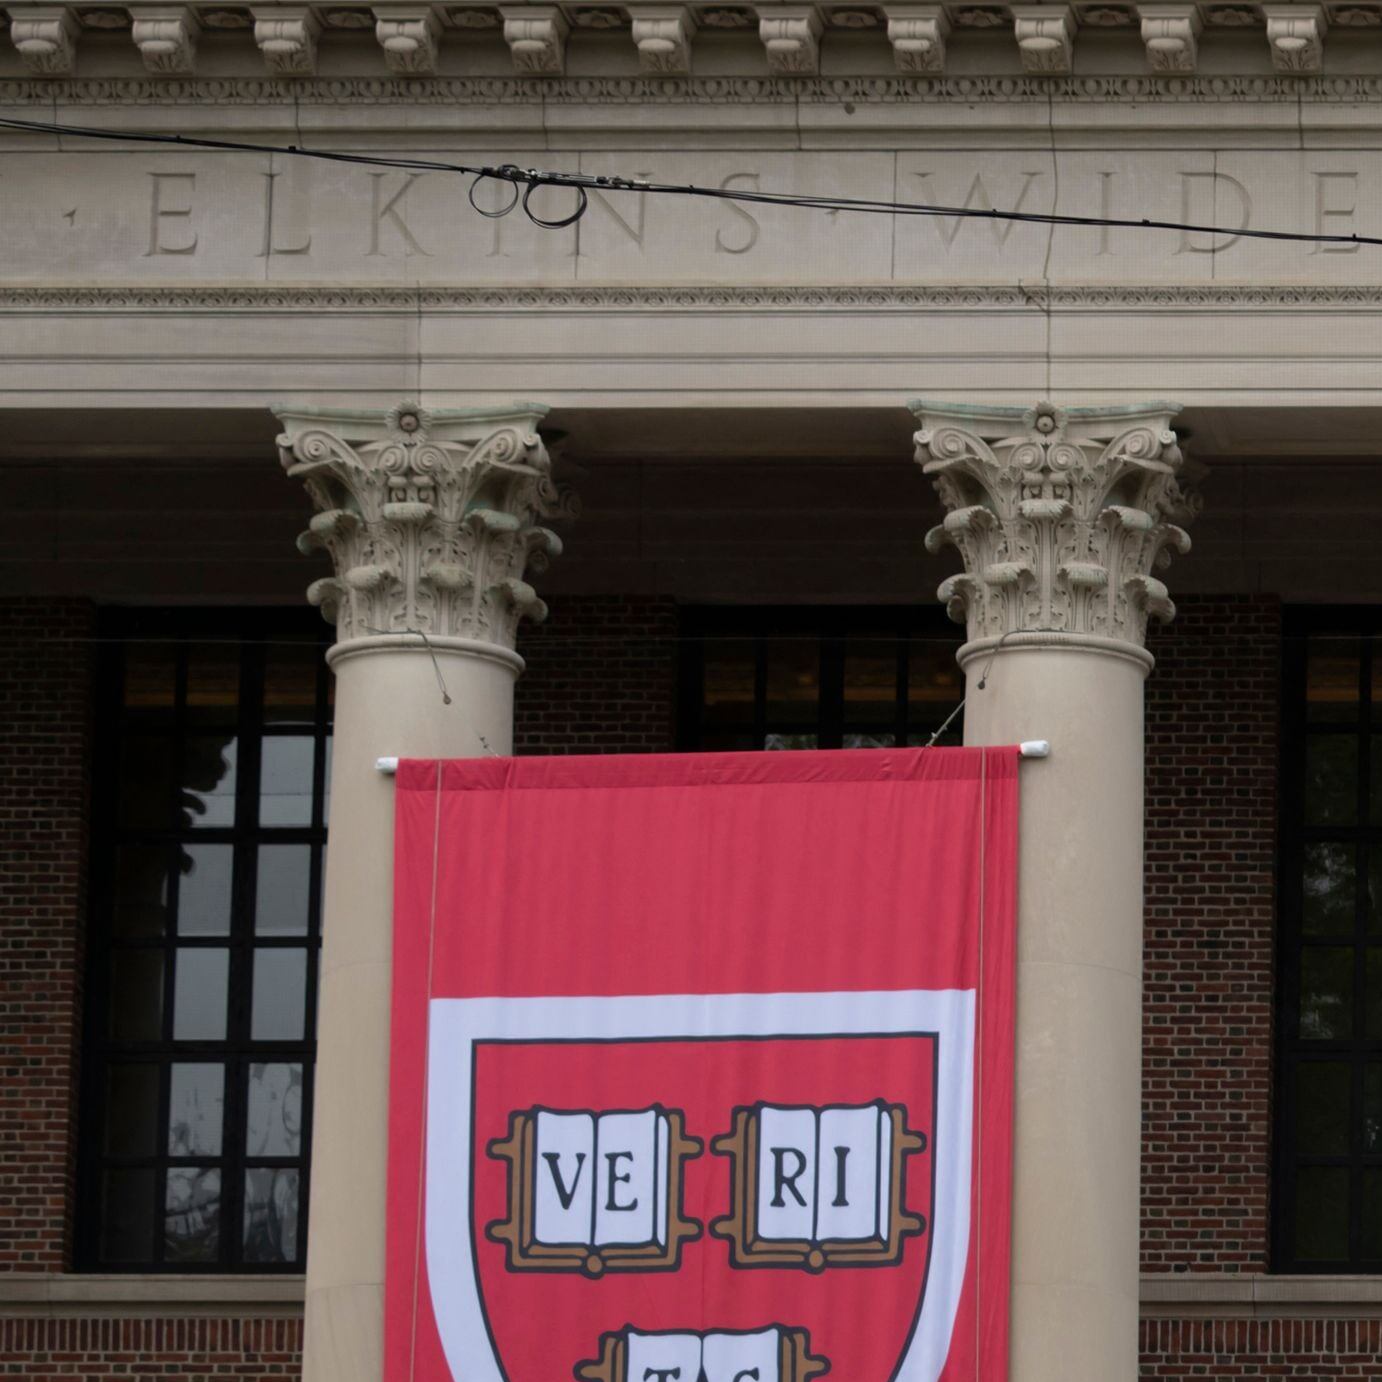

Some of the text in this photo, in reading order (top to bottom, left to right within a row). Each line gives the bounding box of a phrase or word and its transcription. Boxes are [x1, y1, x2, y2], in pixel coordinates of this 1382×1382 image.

[144, 170, 761, 258] ELKINS
[542, 1146, 851, 1211] VE RI
